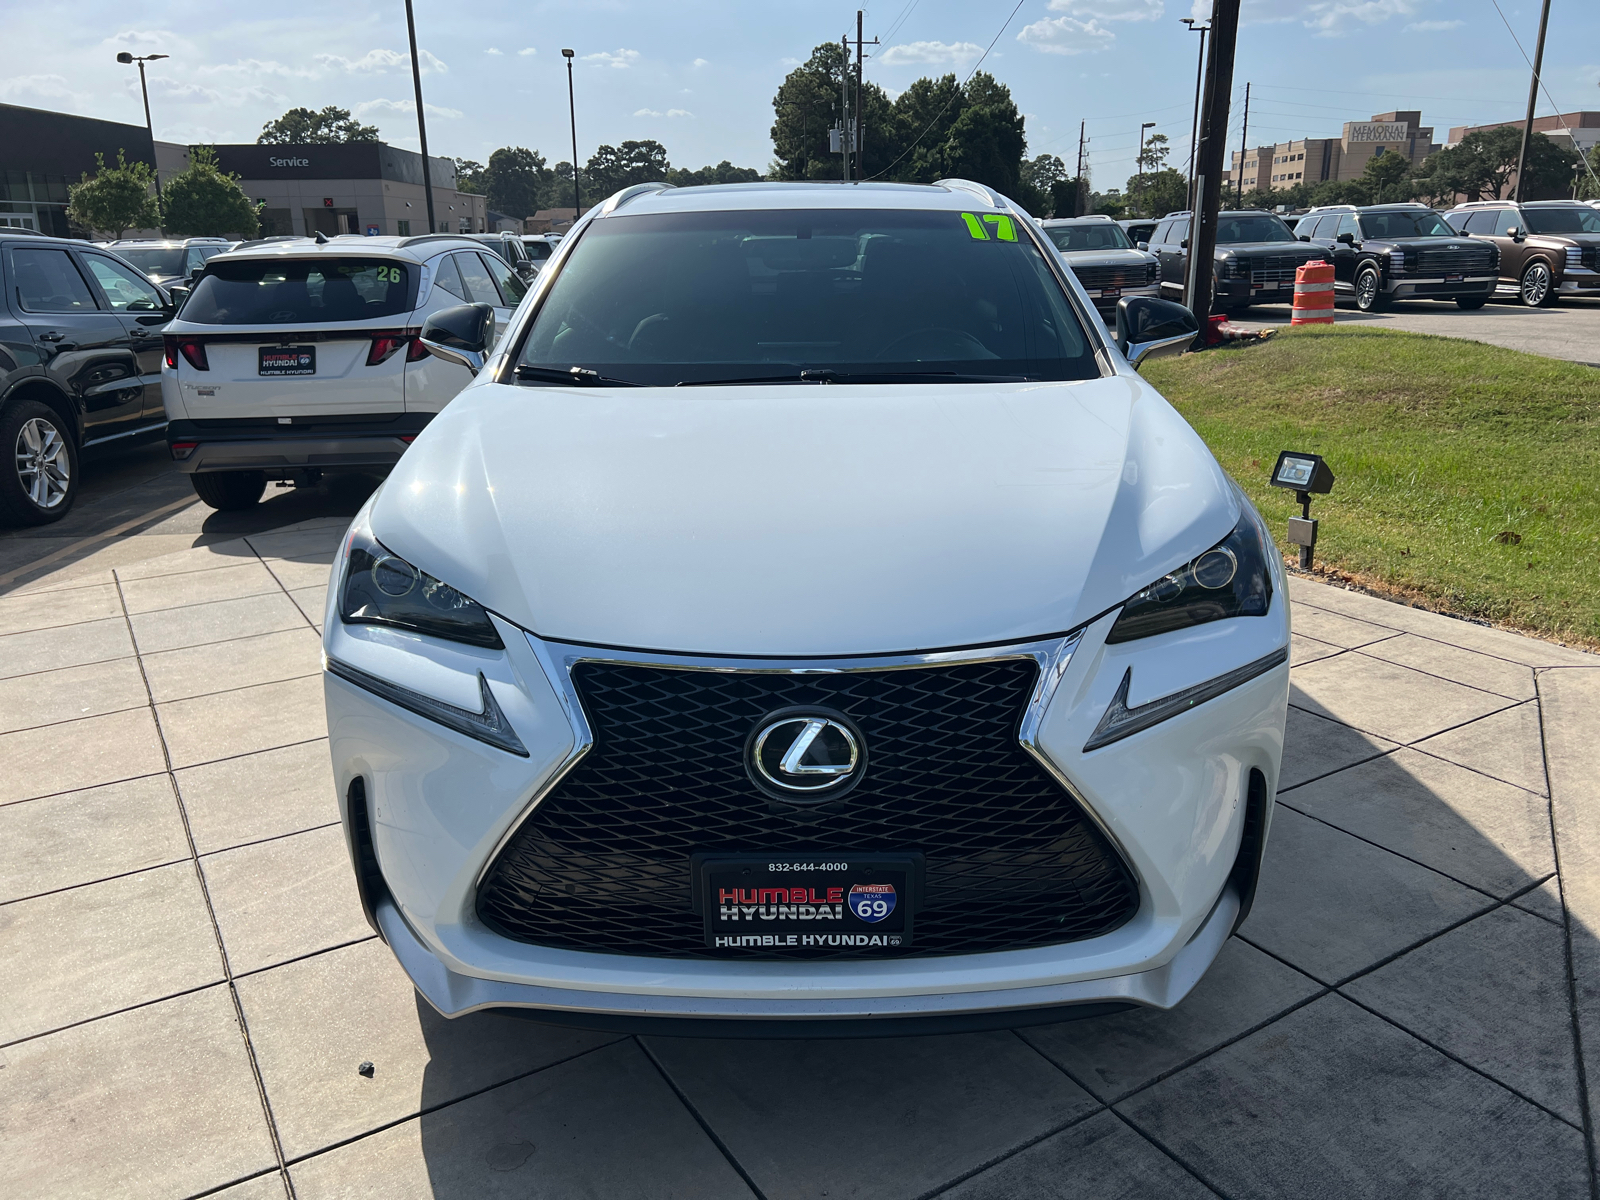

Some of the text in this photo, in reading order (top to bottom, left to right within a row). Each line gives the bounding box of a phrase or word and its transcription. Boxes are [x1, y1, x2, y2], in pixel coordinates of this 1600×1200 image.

[1352, 132, 1405, 141] HERMANN
[1353, 125, 1405, 134] MEMORIAL
[269, 156, 309, 167] Service
[961, 212, 1019, 242] 17
[377, 265, 401, 284] 26
[768, 863, 848, 872] 832-644-4000
[719, 887, 844, 904] HUMBLE
[720, 904, 843, 921] HYUNDAI
[857, 900, 888, 918] 69
[715, 935, 798, 948] HUMBLE
[802, 934, 888, 946] HYUNDAI
